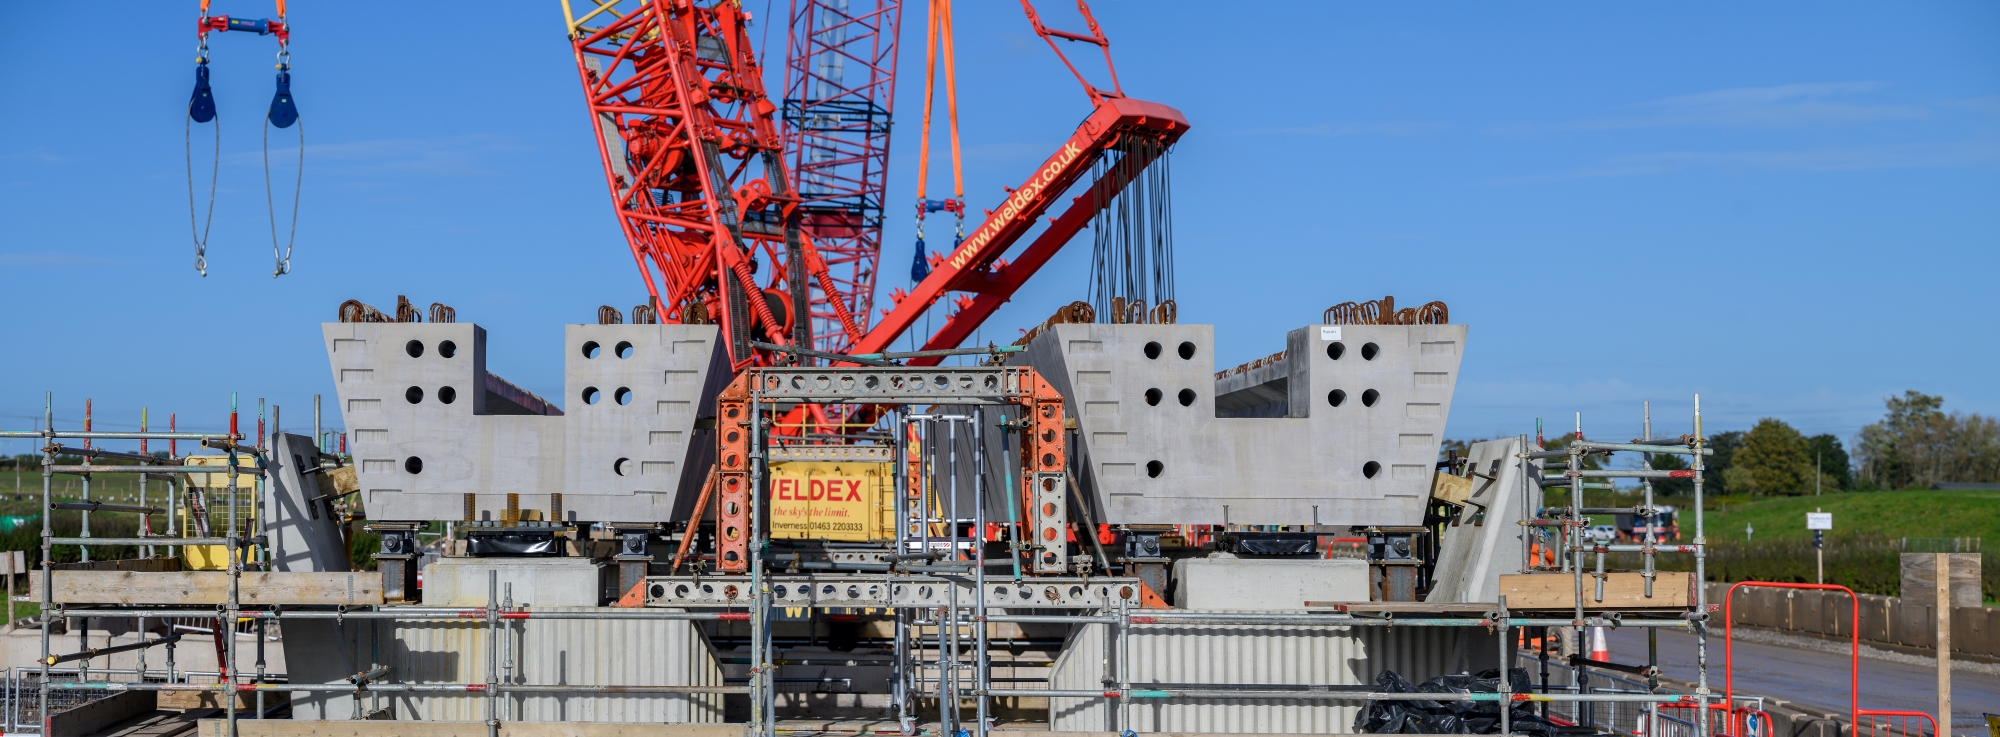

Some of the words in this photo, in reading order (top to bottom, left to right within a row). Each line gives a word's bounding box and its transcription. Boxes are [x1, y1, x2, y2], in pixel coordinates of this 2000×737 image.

[950, 141, 1082, 270] www.weldex.co.uk
[770, 479, 862, 502] ELDEX
[773, 506, 787, 517] the
[788, 506, 807, 519] sky's
[809, 506, 823, 517] the
[772, 521, 808, 530] Inverness
[809, 521, 831, 531] 01463
